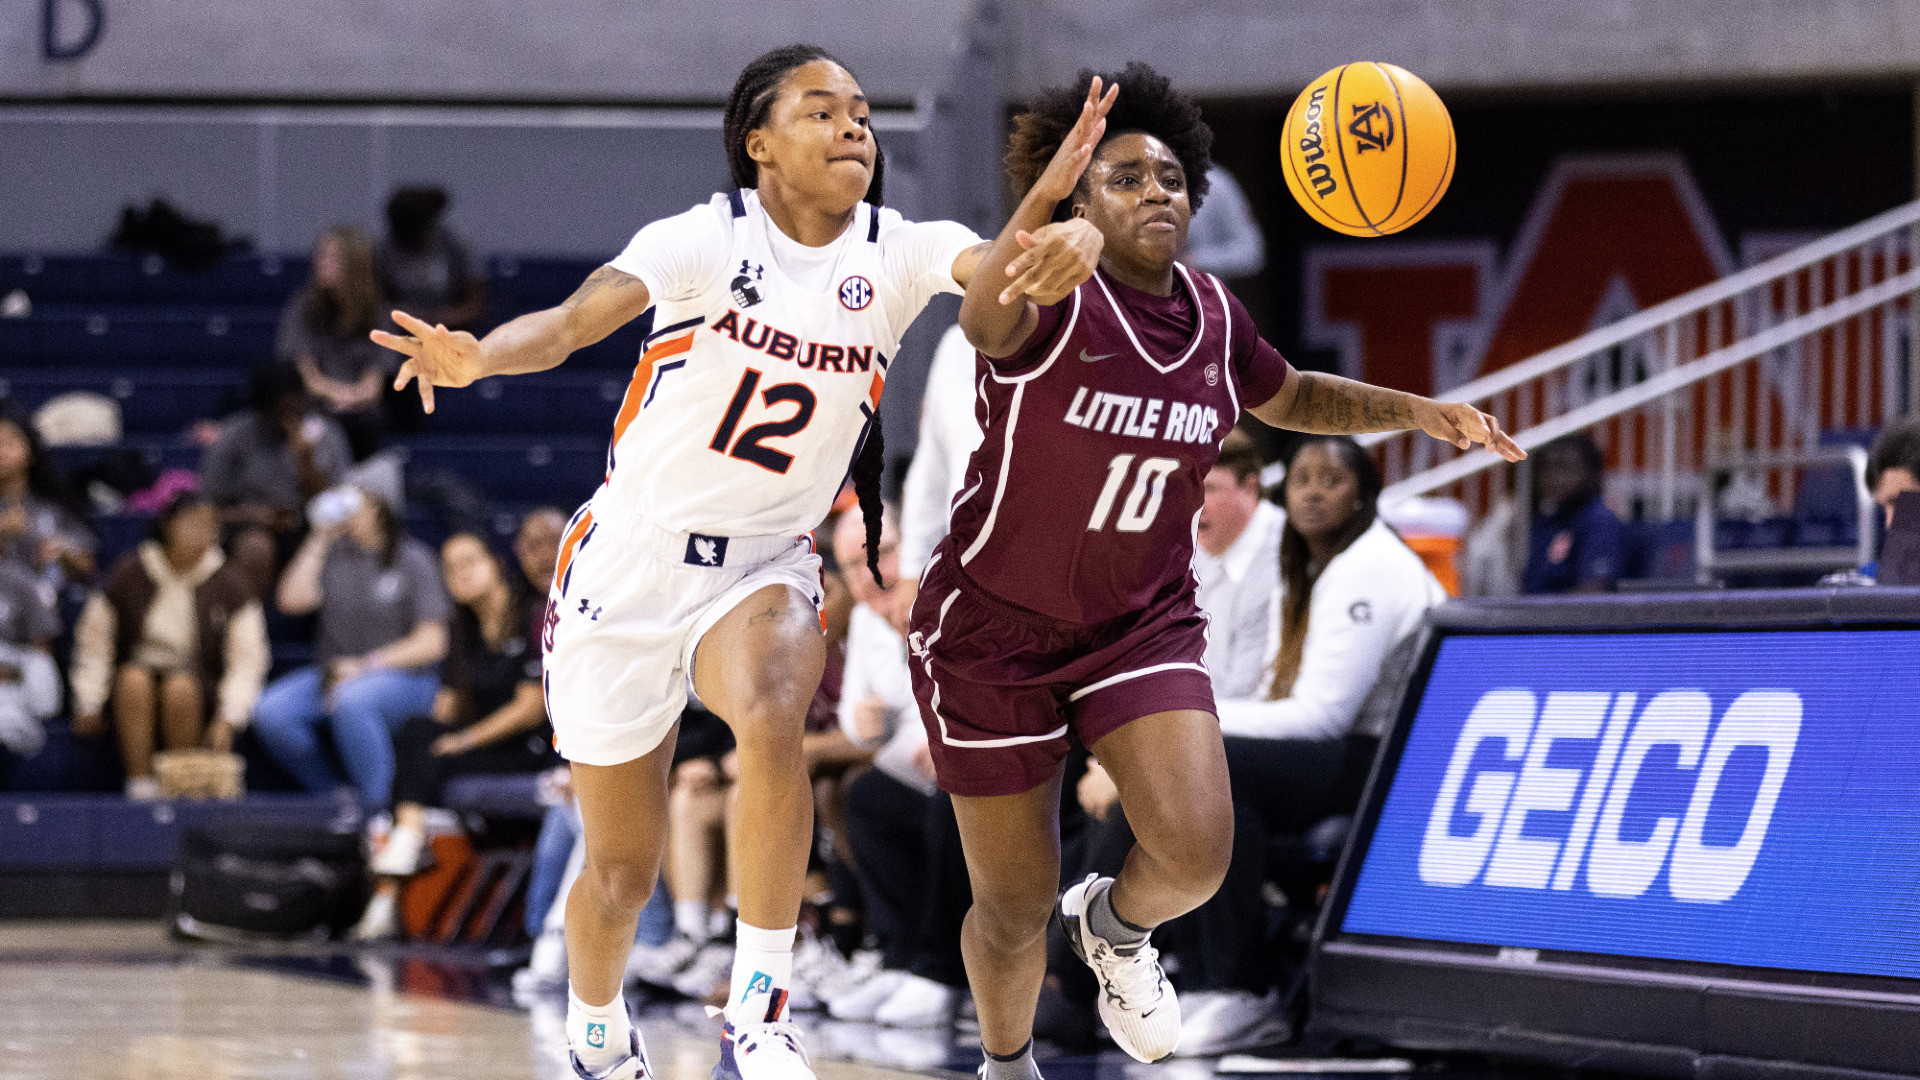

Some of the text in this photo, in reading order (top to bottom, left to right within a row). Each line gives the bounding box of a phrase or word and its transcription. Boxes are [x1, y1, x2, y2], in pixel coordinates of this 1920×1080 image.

[1301, 86, 1337, 200] Wilson
[840, 276, 873, 310] SEC
[711, 308, 874, 373] AUBURN
[708, 366, 817, 475] 12
[1063, 386, 1164, 439] LITTLE
[1086, 453, 1181, 533] 10
[1418, 687, 1803, 904] GEICO
